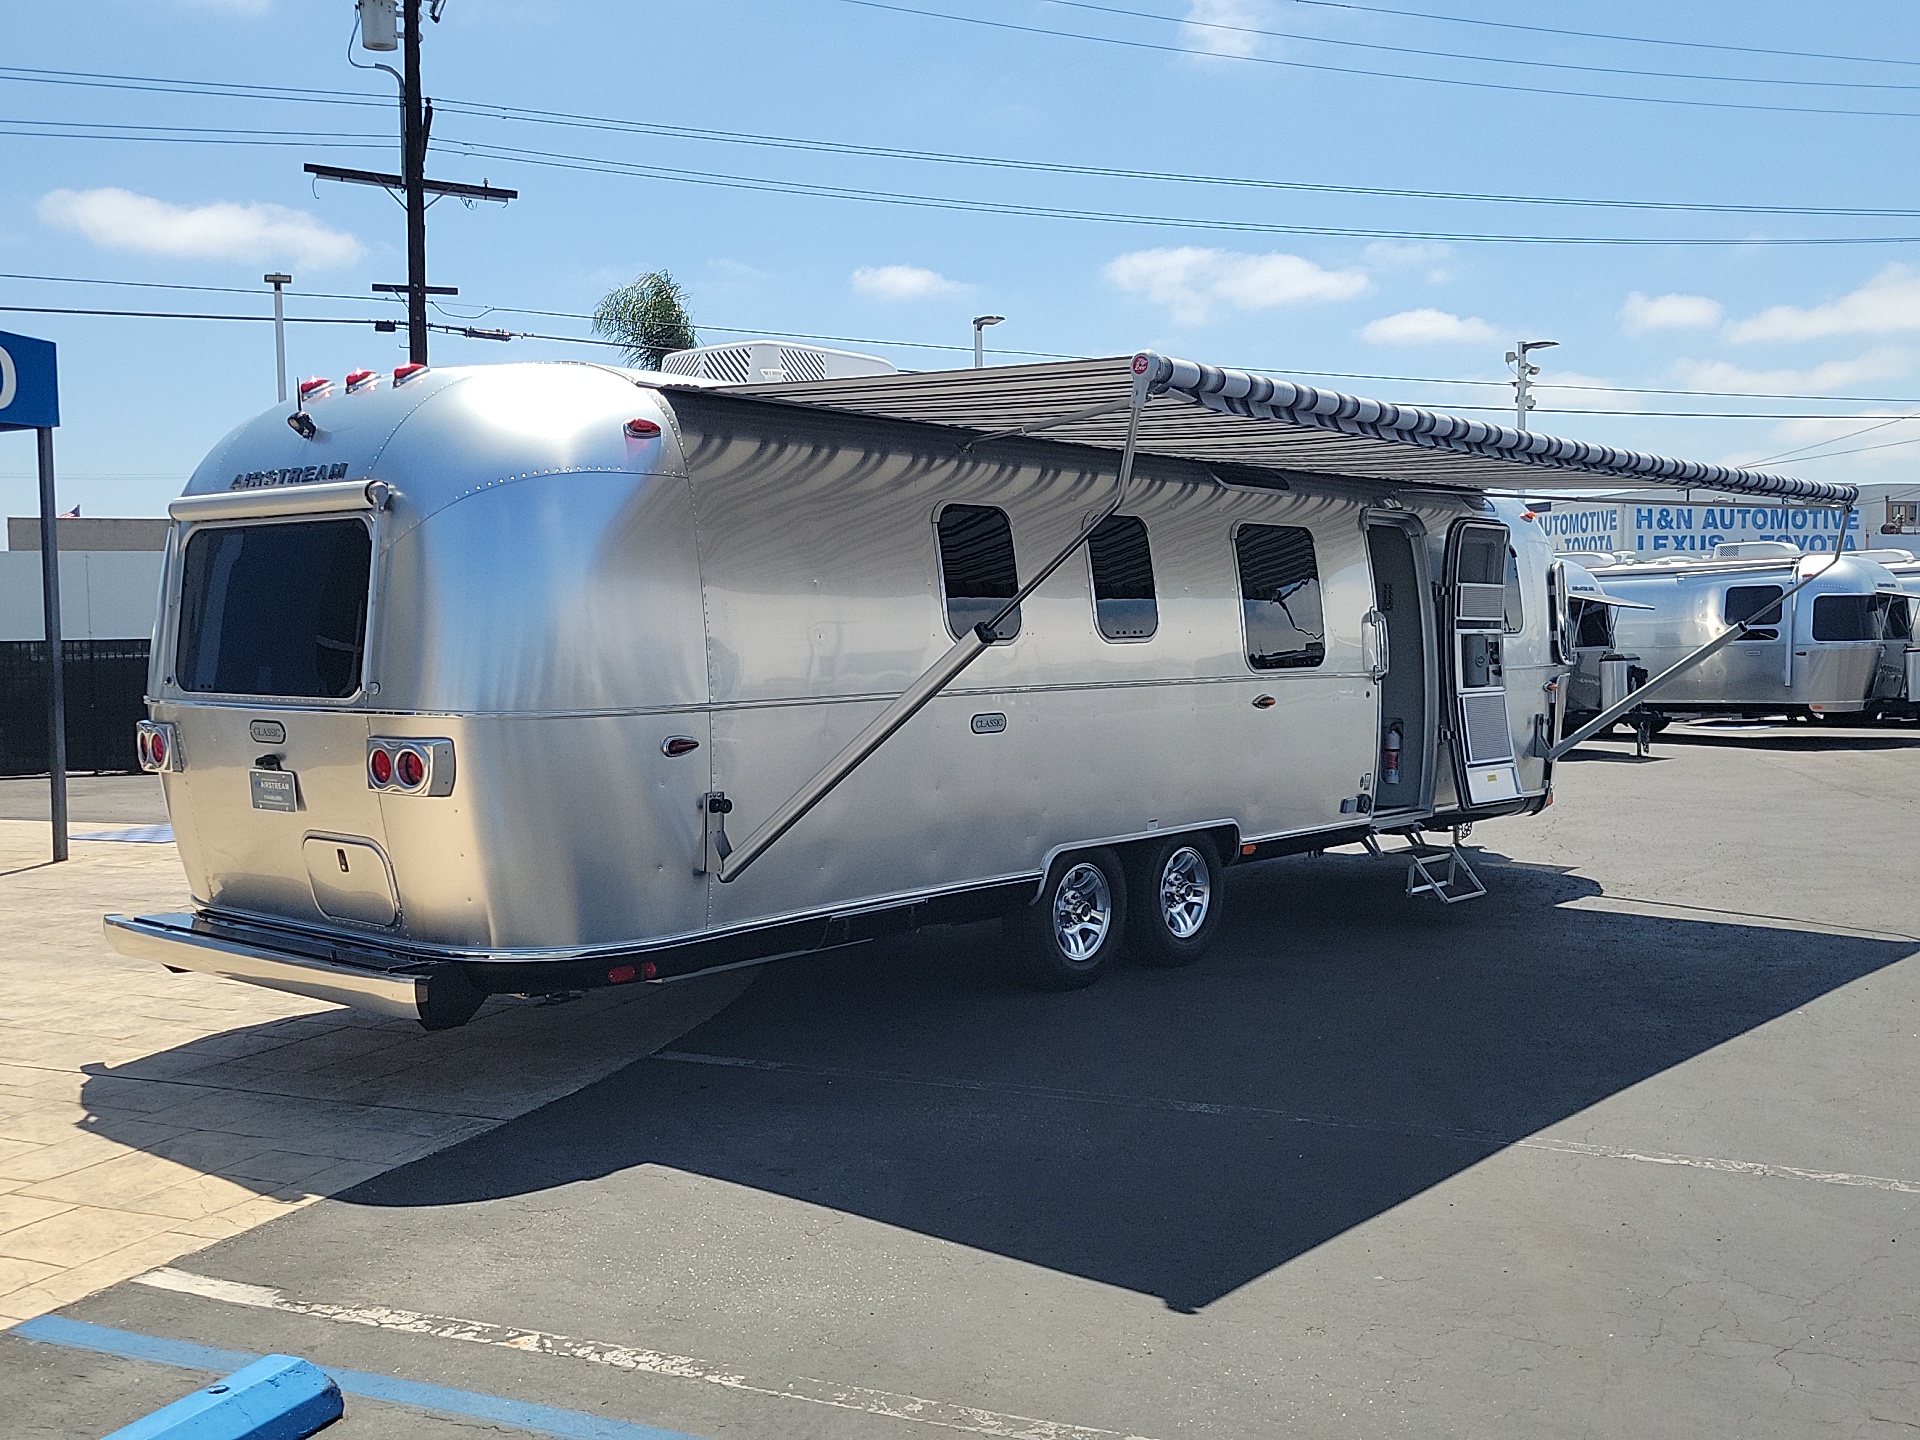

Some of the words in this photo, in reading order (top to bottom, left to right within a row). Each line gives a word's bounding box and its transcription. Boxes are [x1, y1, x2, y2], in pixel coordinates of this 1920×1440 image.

[229, 462, 349, 490] AIRSTREAM
[1636, 508, 1693, 530] H&N
[1702, 508, 1860, 530] AUTOMOTIVE
[1565, 535, 1613, 551] TOYOTA
[975, 718, 1003, 729] CLASSIC
[253, 726, 281, 738] CLASSIC
[260, 781, 290, 790] AIRSTREAM
